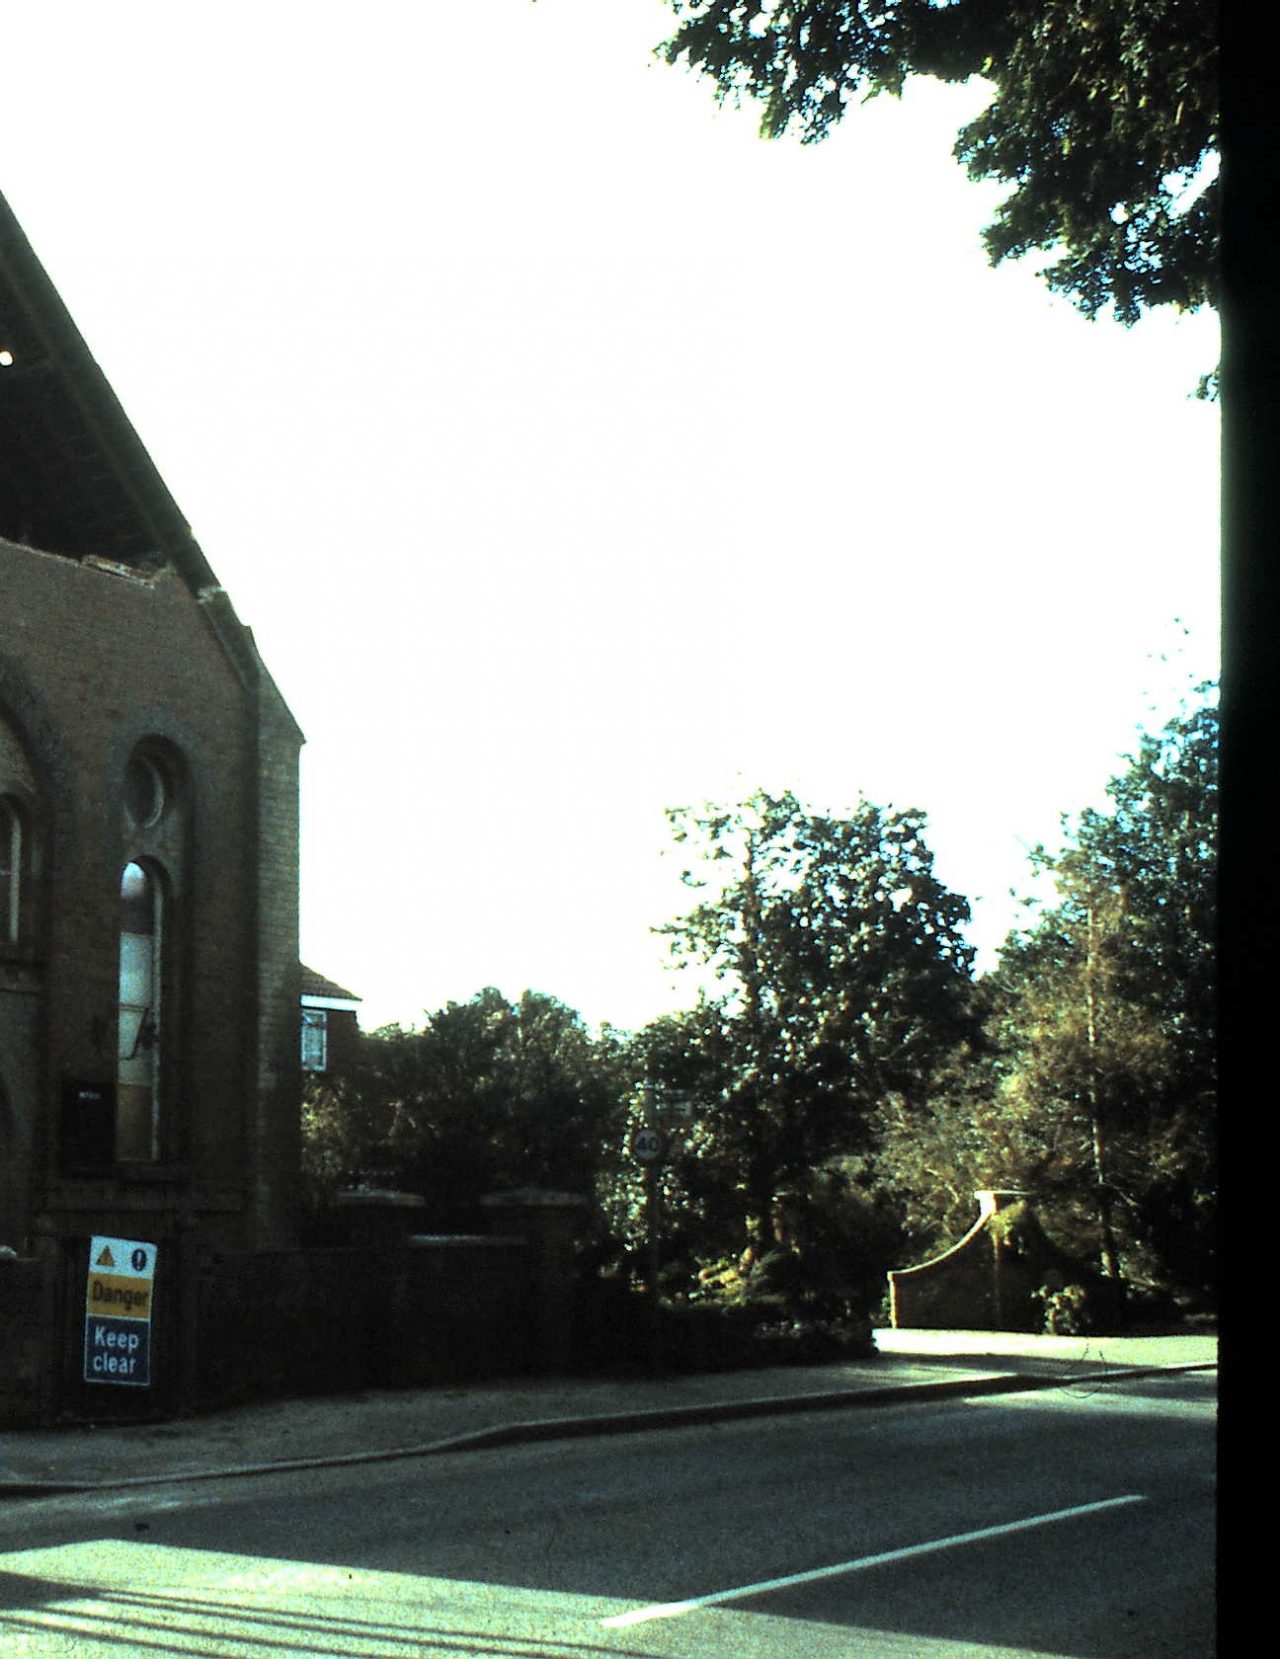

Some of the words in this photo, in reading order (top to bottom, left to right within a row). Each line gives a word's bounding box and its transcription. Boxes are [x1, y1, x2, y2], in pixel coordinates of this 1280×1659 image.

[637, 1137, 658, 1151] 40
[92, 1280, 149, 1311] Danger
[94, 1325, 139, 1353] Keep
[93, 1352, 136, 1373] clear
